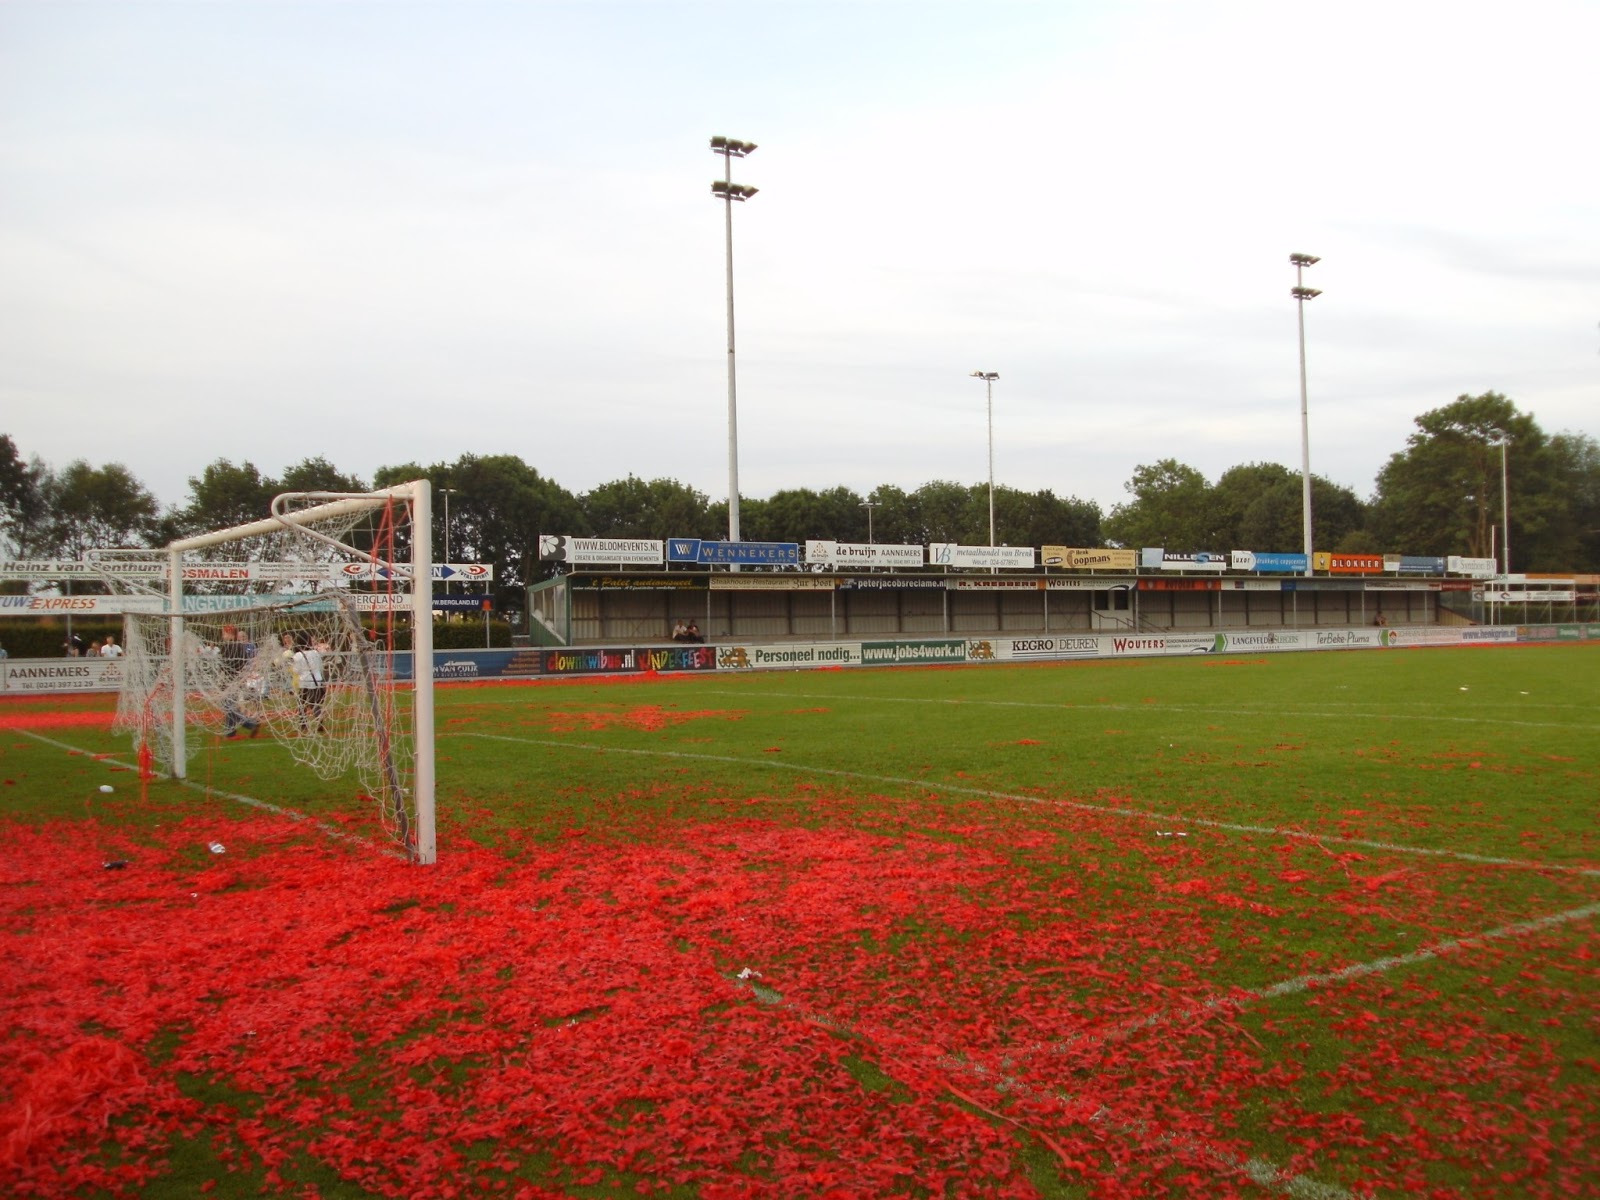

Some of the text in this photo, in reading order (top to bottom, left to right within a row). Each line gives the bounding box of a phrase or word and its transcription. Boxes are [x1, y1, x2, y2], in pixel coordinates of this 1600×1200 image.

[574, 541, 659, 552] WWW.BLOOMEVENTS.NL
[702, 547, 796, 558] WENNEKERS
[836, 547, 921, 558] de bruijn AANNEMERS
[956, 548, 1000, 557] metaalhandel
[1014, 549, 1033, 557] Brenk
[1164, 552, 1224, 562] NILLESEN
[1233, 555, 1251, 564] luxor
[1332, 559, 1380, 568] BLOKKER
[3, 562, 50, 572] Heinz
[56, 564, 84, 572] van
[858, 579, 945, 589] peterjacobsreclame.nl
[1047, 579, 1080, 588] WOUTERS
[0, 597, 96, 609] UW EXPRESS
[168, 596, 250, 612] NGEVELD
[432, 599, 479, 607] W.BERGLAND.EU
[1012, 638, 1099, 651] KEGRO DEUREN
[1113, 638, 1164, 653] WOUTERS
[1232, 636, 1268, 645] LANGEVELD
[755, 647, 860, 663] Personeel nodig...
[863, 643, 965, 661] www.jobs4work.nl
[547, 647, 714, 671] clownkwibus.nl KINDERFEEST
[9, 666, 90, 679] AANNEMERS
[439, 665, 456, 673] VAN
[22, 682, 33, 690] Tel.
[36, 681, 56, 690] (024)
